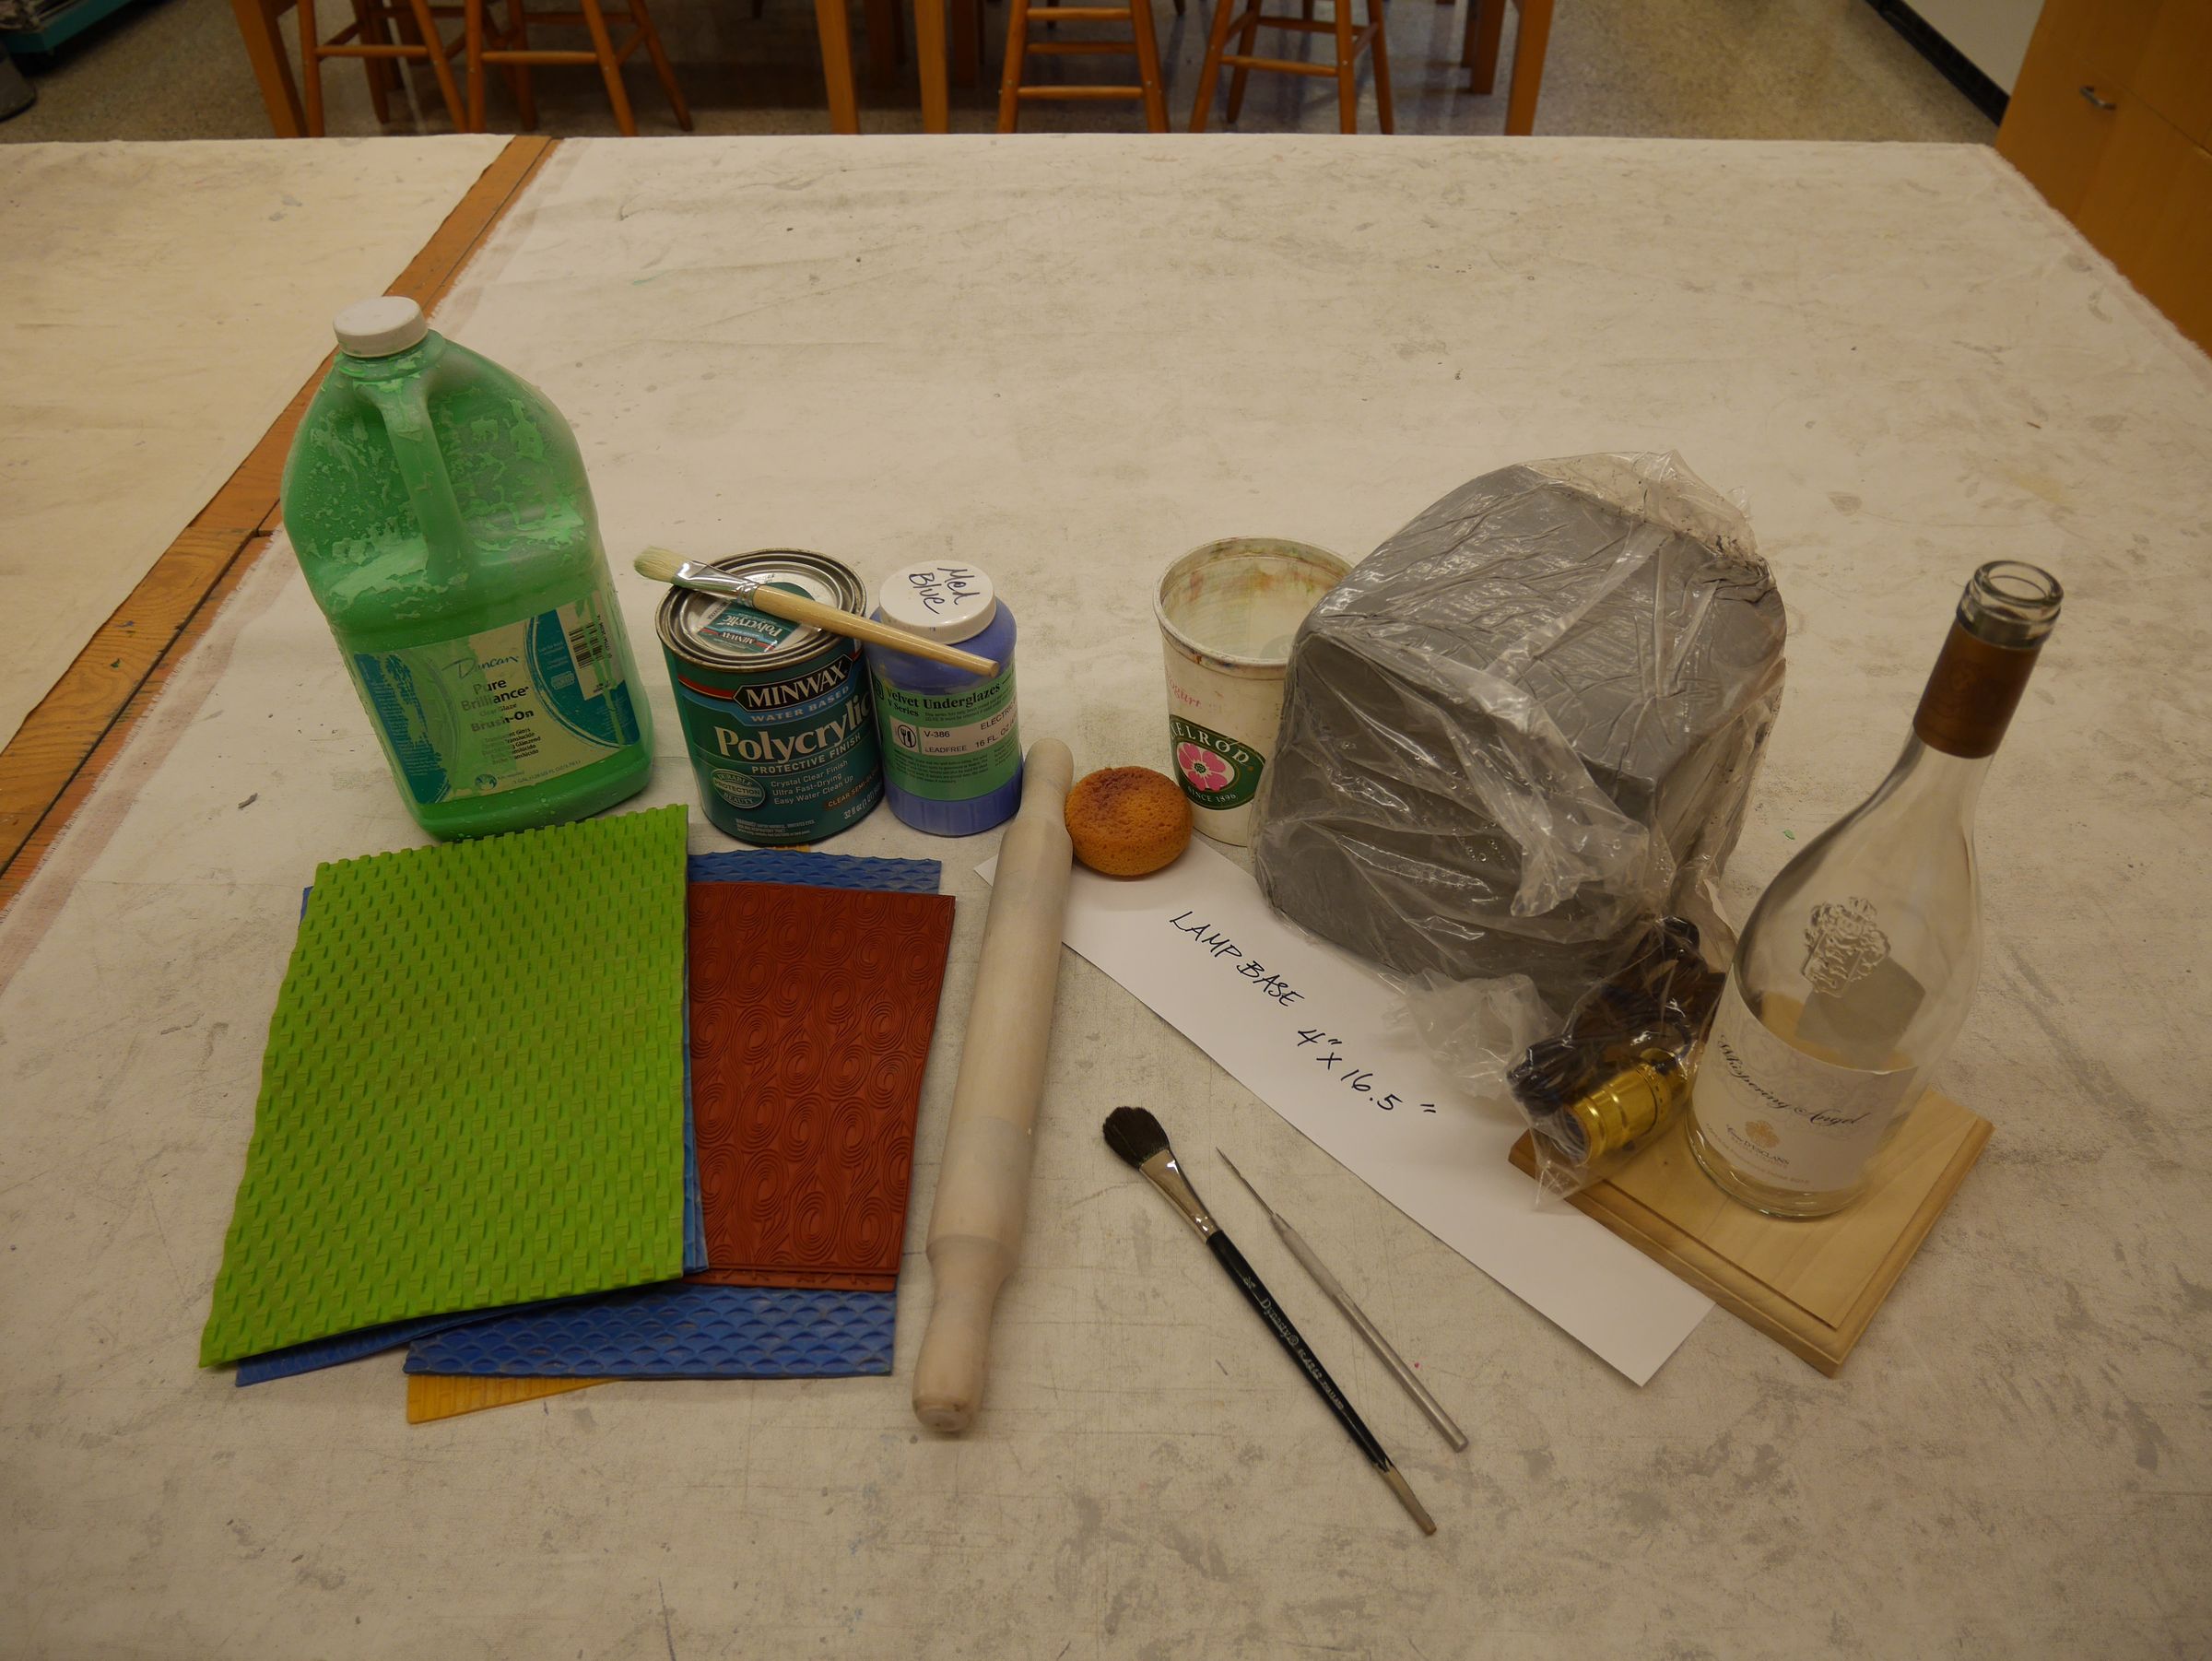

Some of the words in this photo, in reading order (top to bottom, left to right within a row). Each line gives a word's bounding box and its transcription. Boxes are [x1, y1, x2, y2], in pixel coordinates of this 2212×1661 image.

[909, 571, 946, 615] Blue
[936, 567, 981, 606] Med
[722, 615, 782, 637] Polycrylic
[473, 678, 507, 696] Pure
[747, 661, 846, 708] MINWAX
[886, 686, 920, 708] Velvet
[924, 682, 1001, 710] Underglazes
[461, 686, 527, 713] Brilliance
[751, 708, 804, 724] WATER
[808, 686, 850, 712] BASED
[894, 703, 920, 717] Series
[471, 709, 535, 733] Brush-On
[713, 692, 872, 765] Polycrylic
[924, 730, 950, 738] V-386
[751, 753, 826, 774] PROTECTIVE
[829, 733, 861, 759] FINISH
[924, 746, 967, 754] LEADFREE
[976, 739, 985, 748] 16
[771, 777, 801, 788] Crystal
[803, 772, 824, 783] Clear
[826, 760, 848, 774] Finish
[772, 788, 794, 796] Ultra
[795, 773, 842, 794] Fast-Drying
[724, 792, 754, 805] BEAUTY
[796, 791, 820, 802] Water
[822, 782, 843, 795] Clean
[844, 775, 853, 783] Up
[828, 794, 851, 807] CLEAR
[1186, 784, 1213, 804] SINCE
[1216, 792, 1236, 804] 1896
[1169, 911, 1242, 958] LAMP
[1236, 960, 1305, 1007] BASE
[1718, 1034, 1794, 1110] Whispering
[1794, 1105, 1872, 1127] Angel
